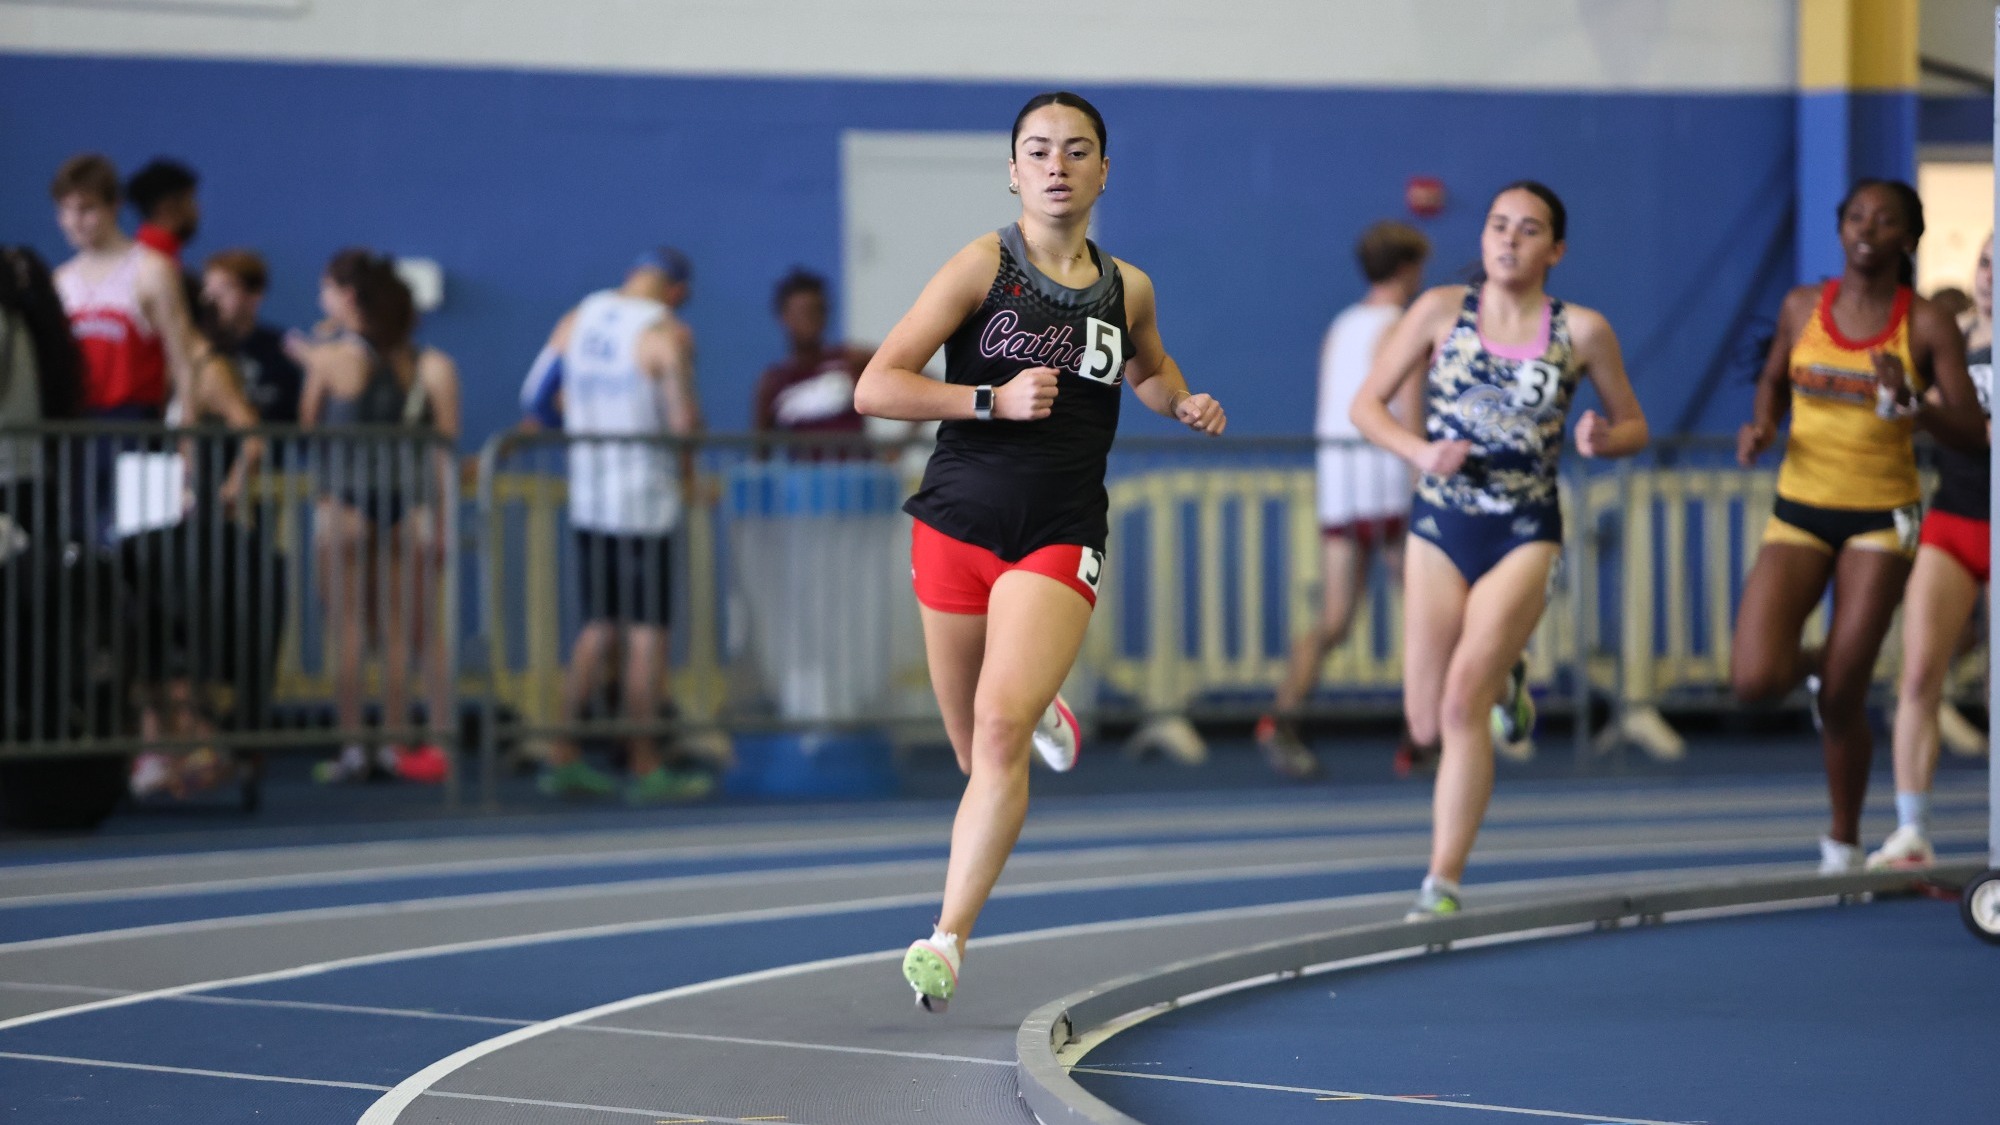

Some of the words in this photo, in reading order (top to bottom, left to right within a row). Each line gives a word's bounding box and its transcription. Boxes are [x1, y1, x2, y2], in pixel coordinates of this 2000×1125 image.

[980, 310, 1125, 384] Catho
[1089, 323, 1114, 379] 5
[1522, 366, 1549, 408] 3
